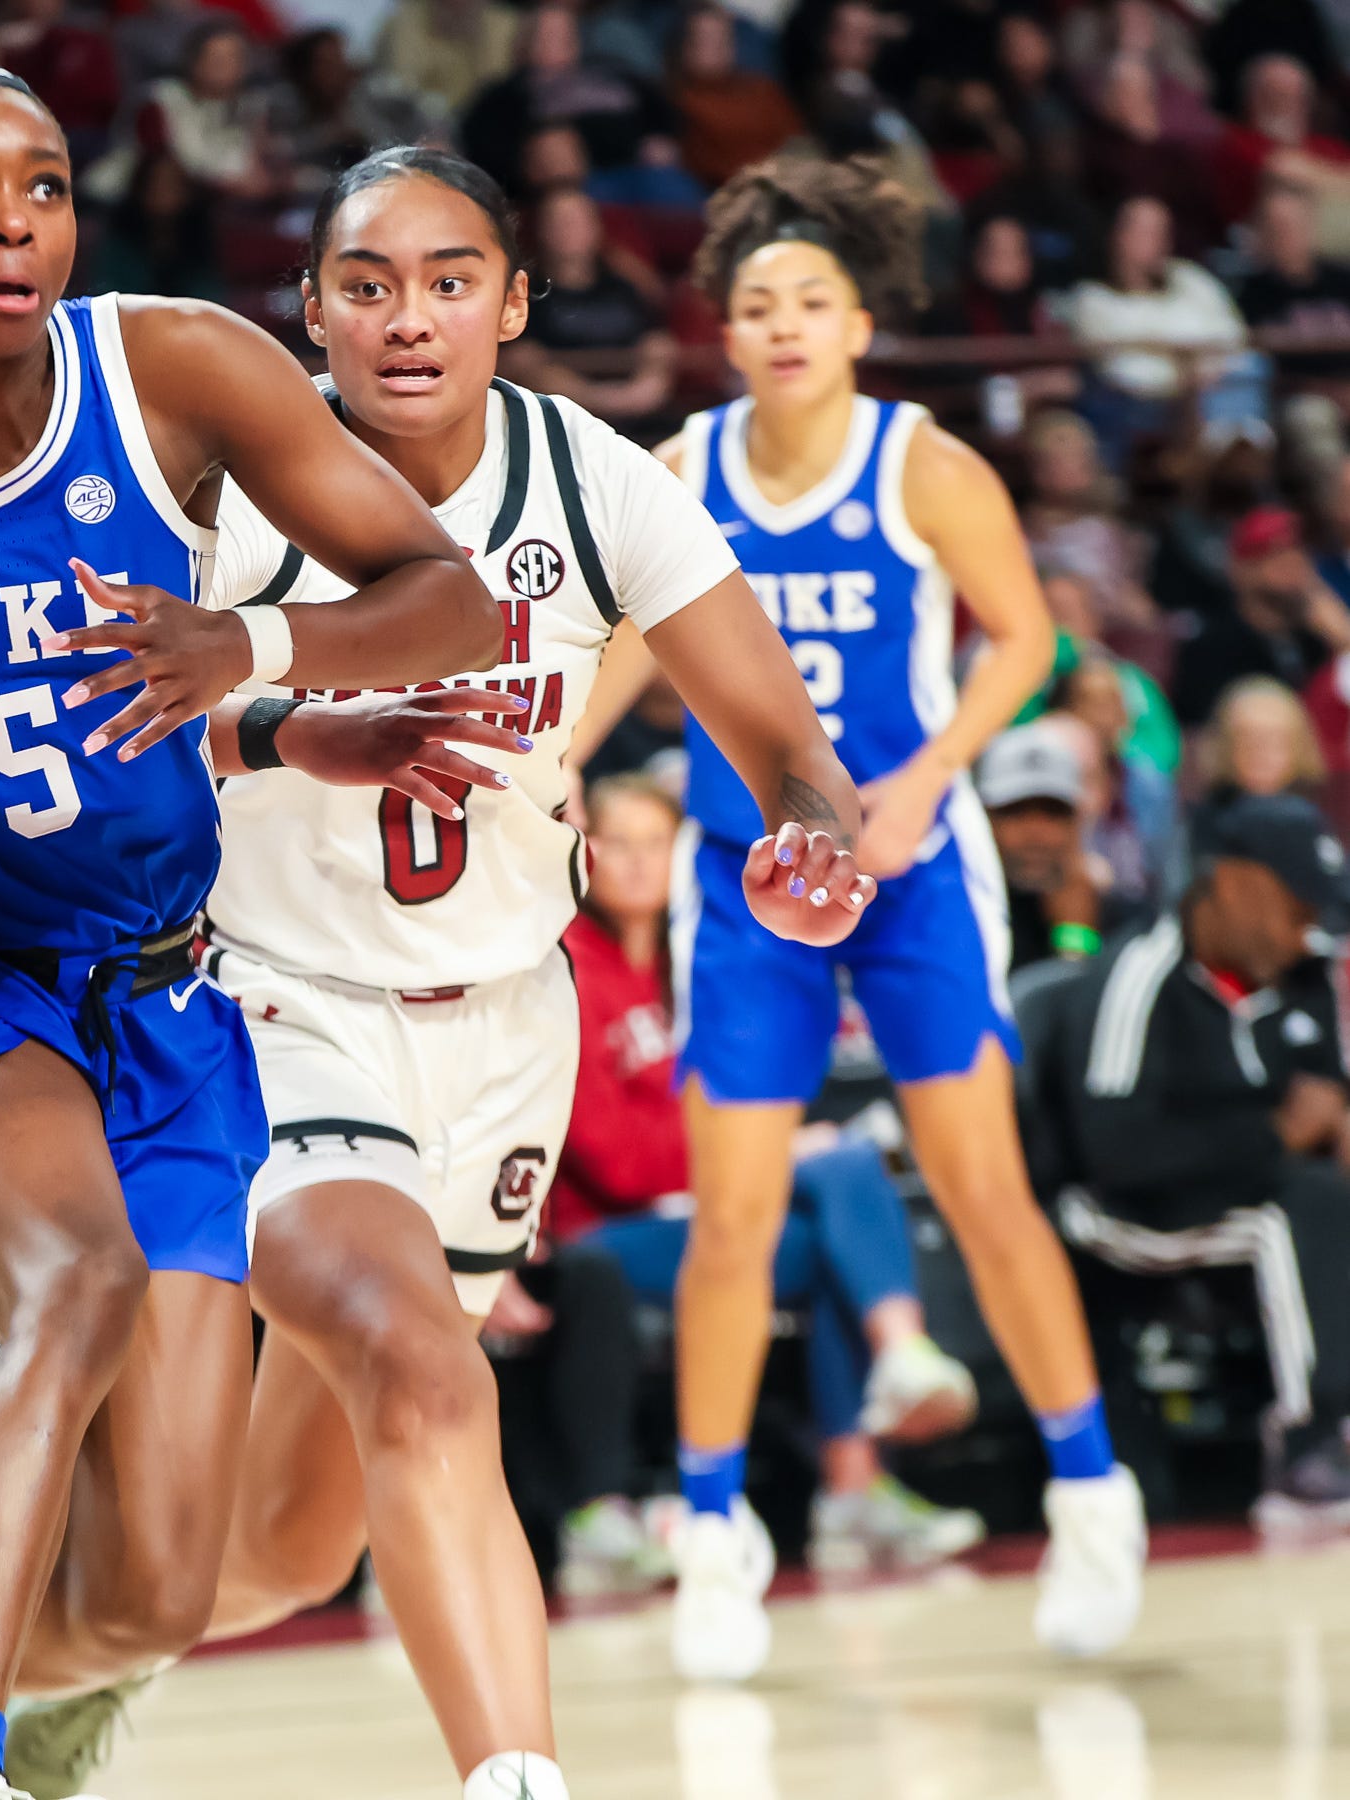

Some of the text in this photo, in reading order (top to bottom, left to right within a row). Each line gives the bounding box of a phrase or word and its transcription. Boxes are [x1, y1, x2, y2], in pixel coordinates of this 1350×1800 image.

[73, 487, 108, 505] ACC
[510, 543, 561, 597] SEC
[378, 766, 471, 905] 0
